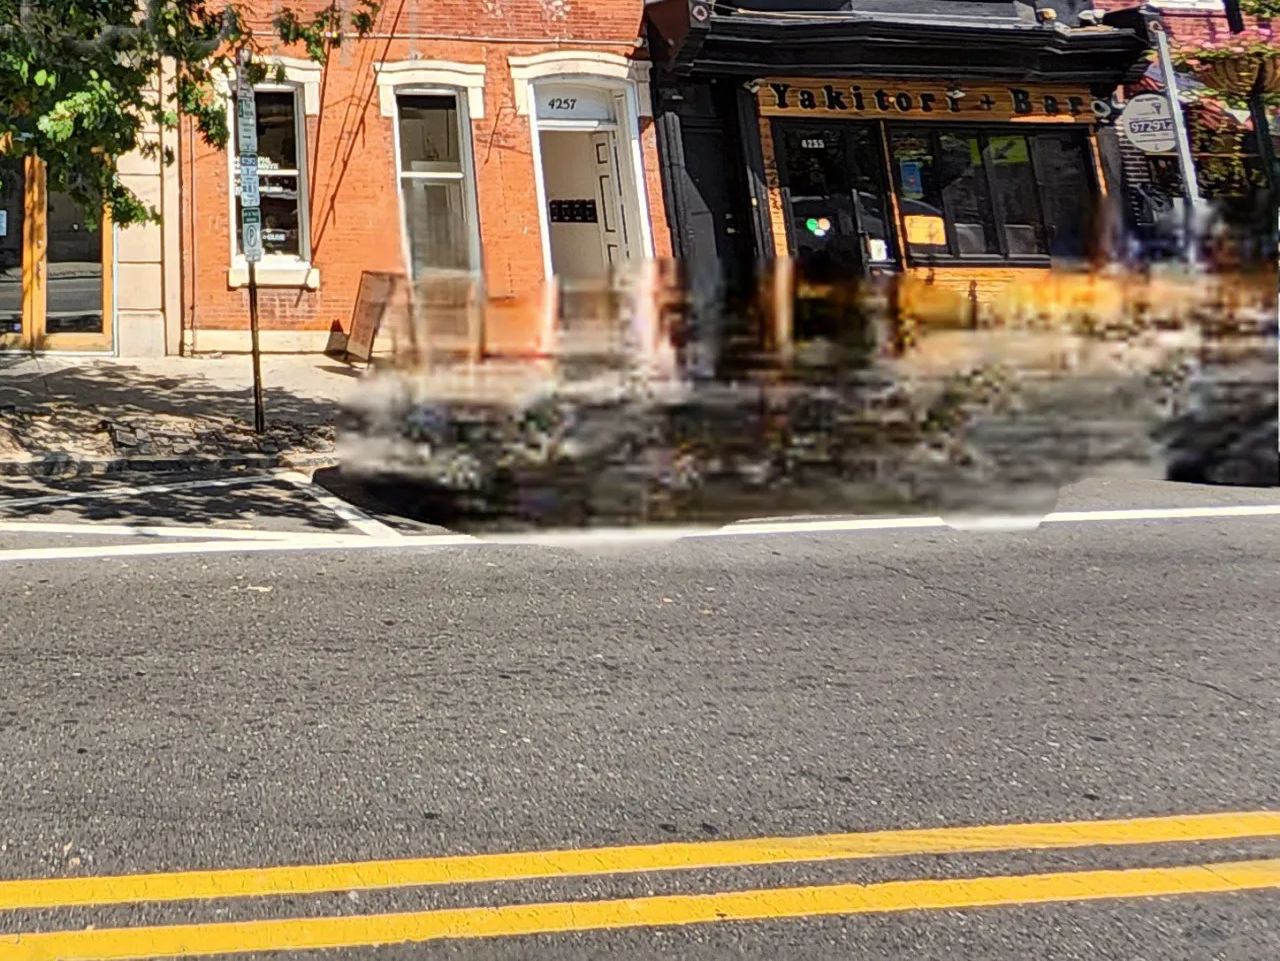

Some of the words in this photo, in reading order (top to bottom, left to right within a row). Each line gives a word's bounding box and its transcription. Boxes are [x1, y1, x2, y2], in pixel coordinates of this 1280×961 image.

[548, 98, 577, 110] 4257
[768, 82, 960, 113] Yakitori
[1008, 88, 1084, 115] Bar
